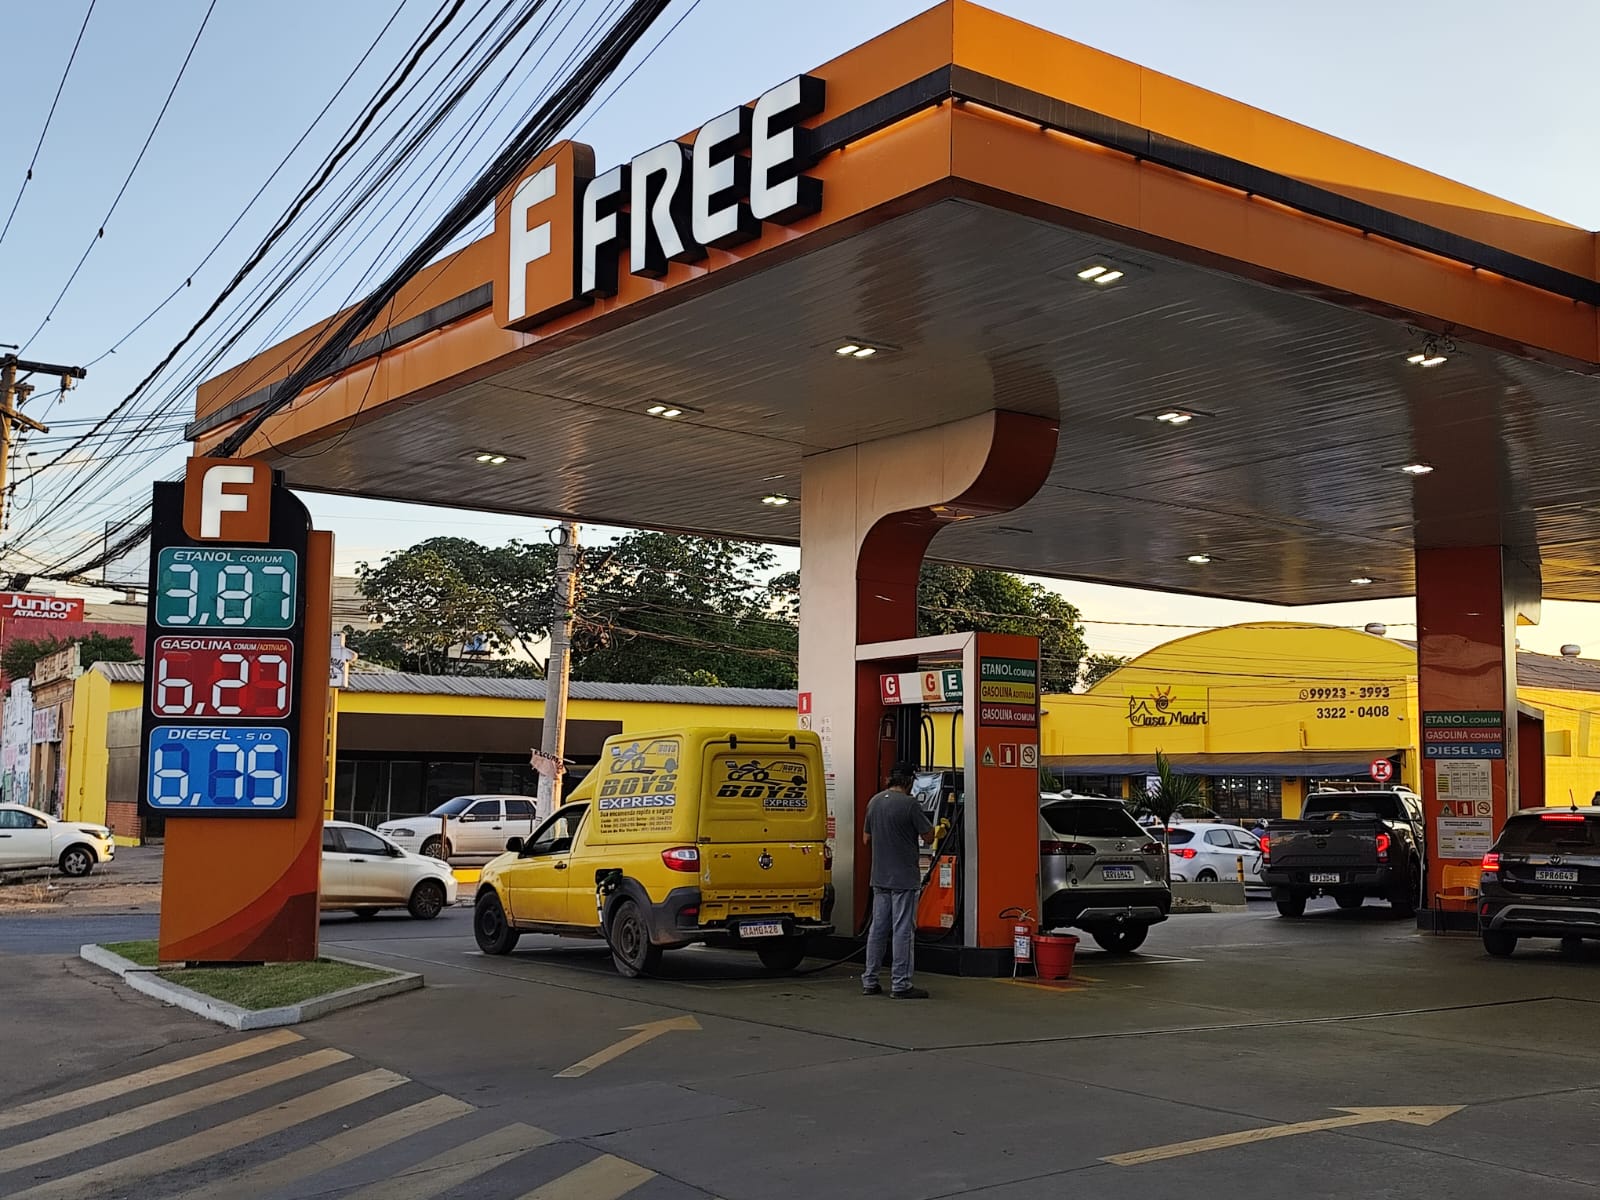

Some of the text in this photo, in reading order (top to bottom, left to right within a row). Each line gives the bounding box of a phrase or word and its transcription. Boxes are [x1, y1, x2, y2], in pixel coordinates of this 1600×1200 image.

[581, 75, 801, 294] FREE
[508, 163, 557, 322] F
[200, 465, 254, 539] F
[173, 551, 283, 564] ETANOL COMUM
[165, 563, 291, 626] 3,87
[2, 595, 78, 613] Junior
[13, 609, 68, 620] ATACADO
[161, 639, 232, 651] GASOLINA
[982, 663, 1036, 678] ETANOL COMUM
[157, 654, 288, 715] 6,27
[885, 676, 896, 695] G
[925, 673, 936, 692] G
[947, 673, 959, 690] E
[982, 686, 1013, 698] GASOLINA
[1309, 687, 1347, 699] 99923
[1359, 686, 1390, 698] 3993
[982, 708, 1036, 721] GASOLINA COMUM
[1168, 711, 1209, 726] Madri
[1316, 707, 1347, 719] 3322
[1357, 706, 1390, 718] 0408
[1425, 715, 1469, 724] ETANOL
[168, 729, 231, 740] DIESEL
[1426, 730, 1469, 740] GASOLINA
[1427, 746, 1478, 755] DIESEL
[152, 743, 283, 806] 6,75
[600, 774, 678, 797] BOYS
[716, 784, 807, 798] BOYS
[599, 795, 677, 810] EXPRESS
[764, 799, 807, 807] EXPRESS
